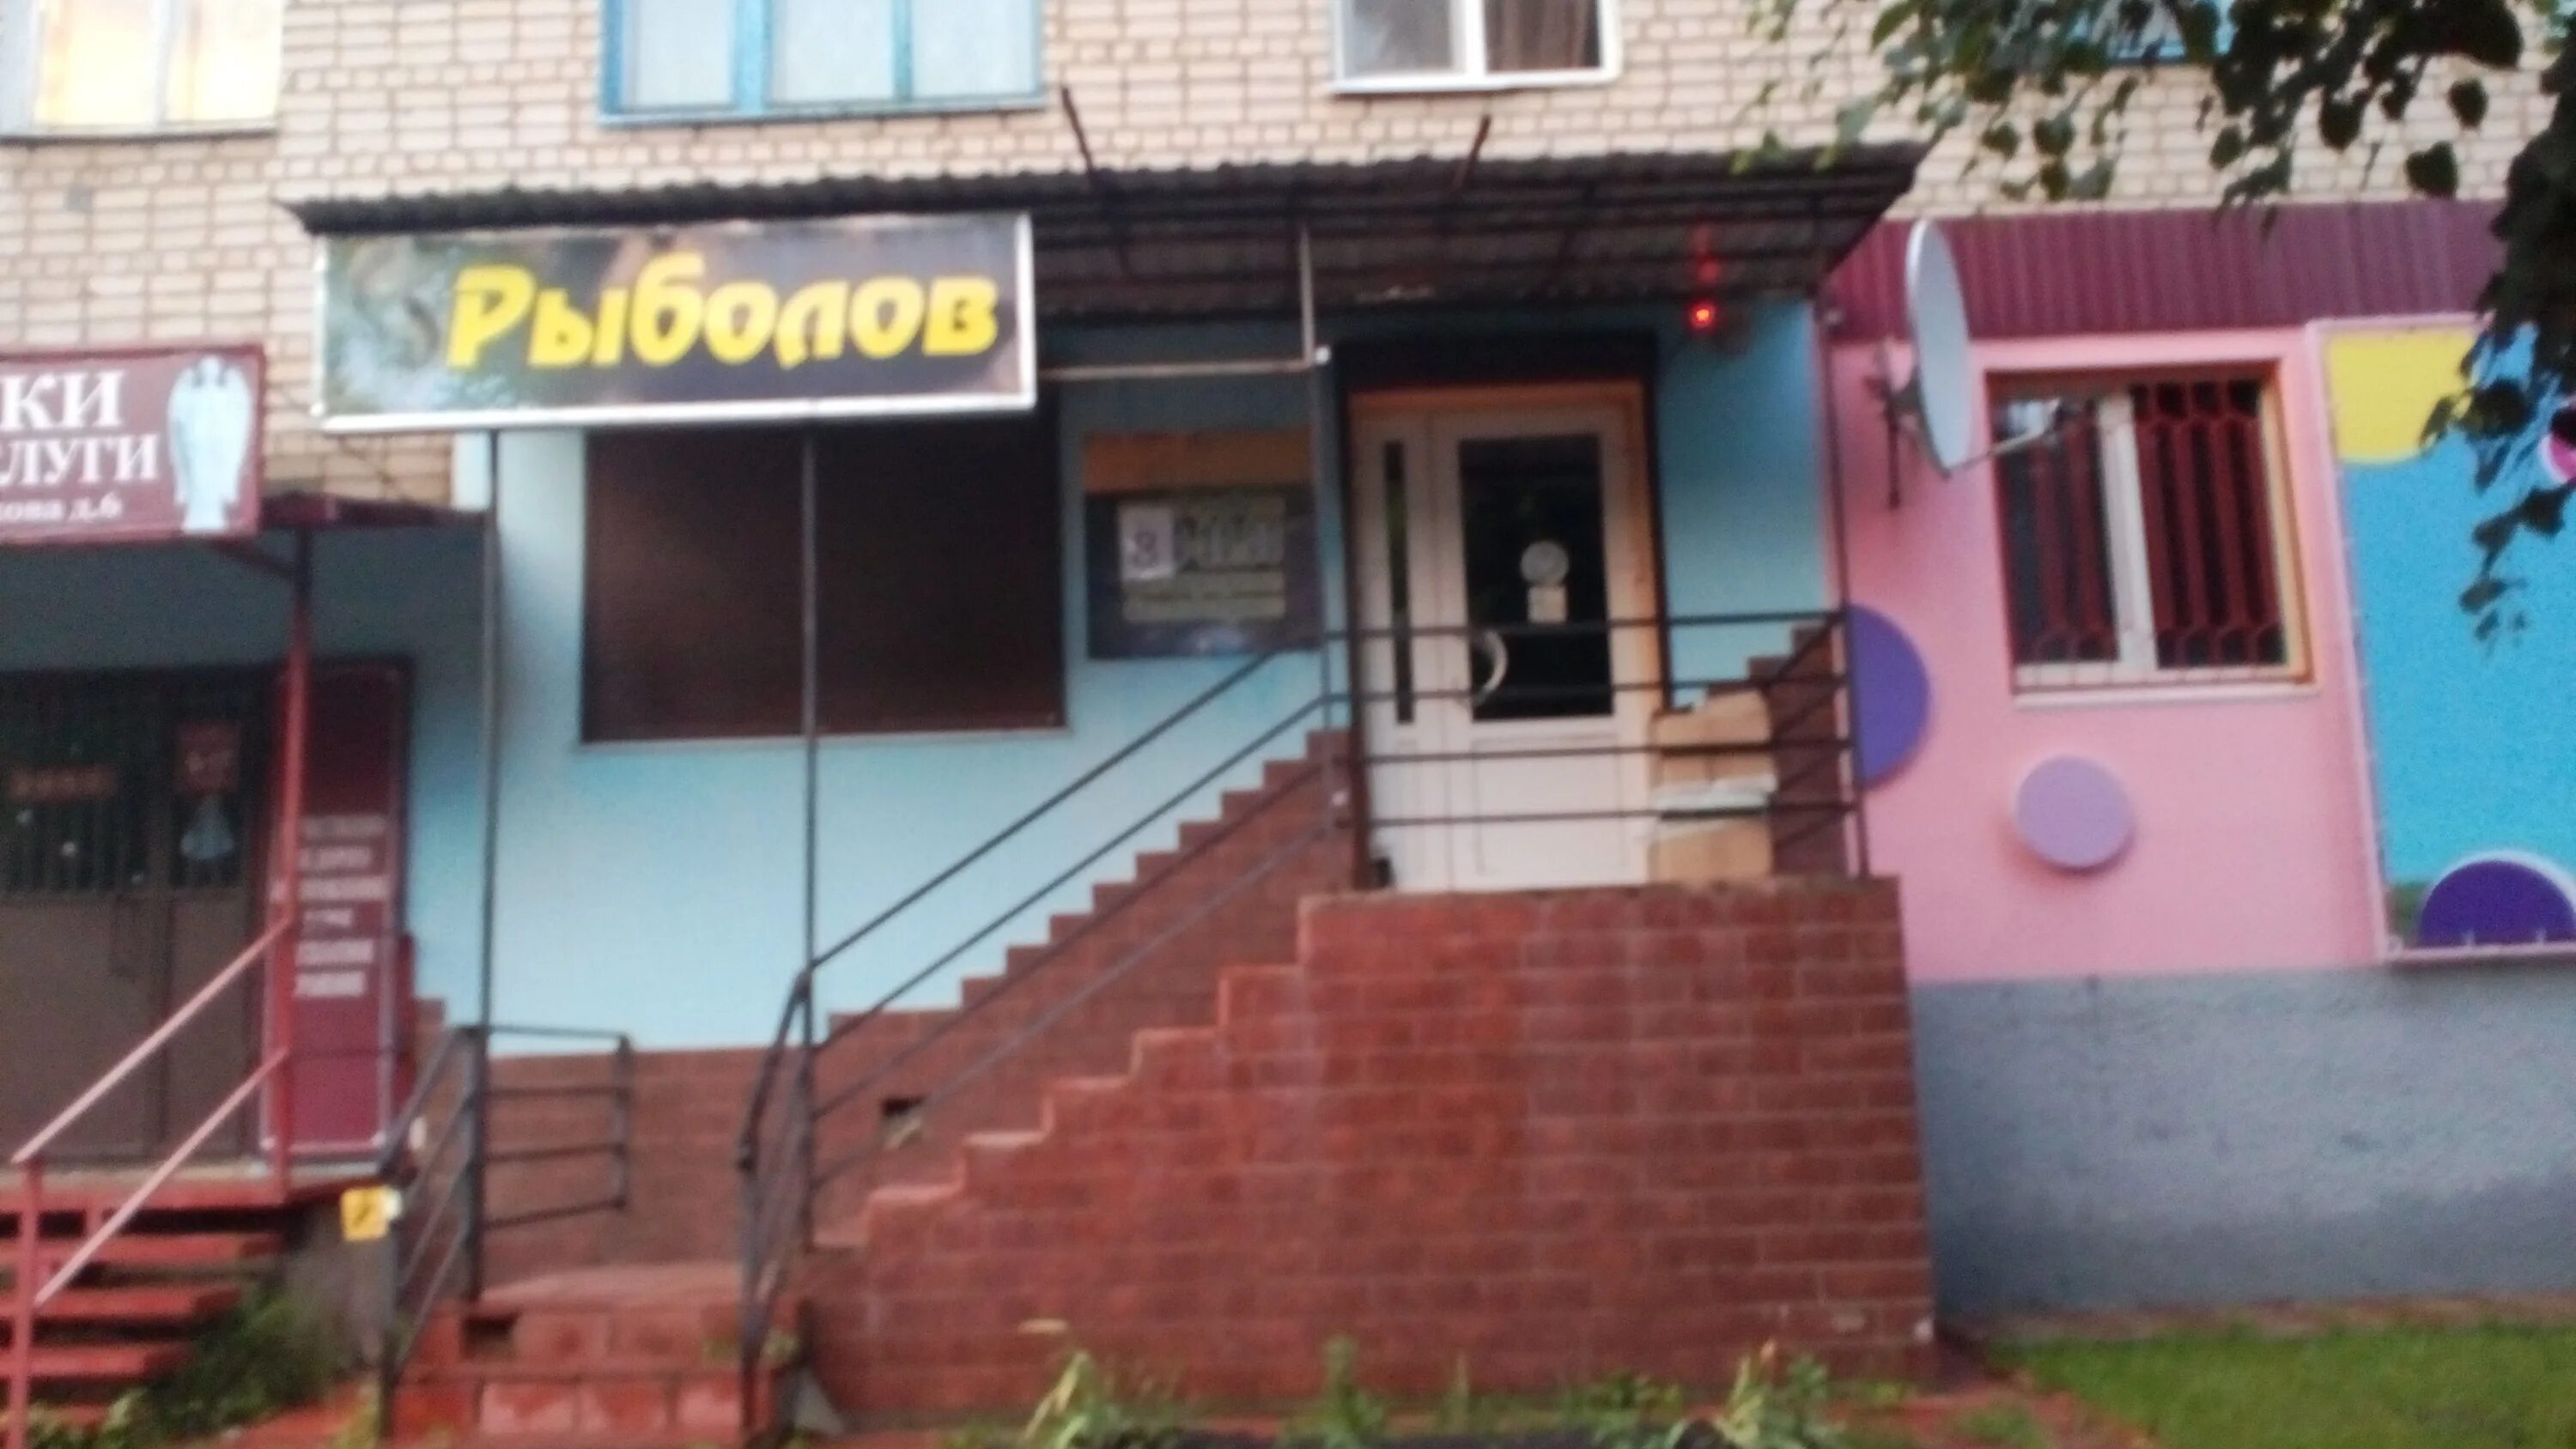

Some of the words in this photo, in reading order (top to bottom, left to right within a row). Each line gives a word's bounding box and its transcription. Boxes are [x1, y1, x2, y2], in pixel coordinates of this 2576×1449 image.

[448, 252, 998, 369] Рыболов
[0, 371, 125, 430] КИ
[0, 434, 159, 486] ЛУГИ
